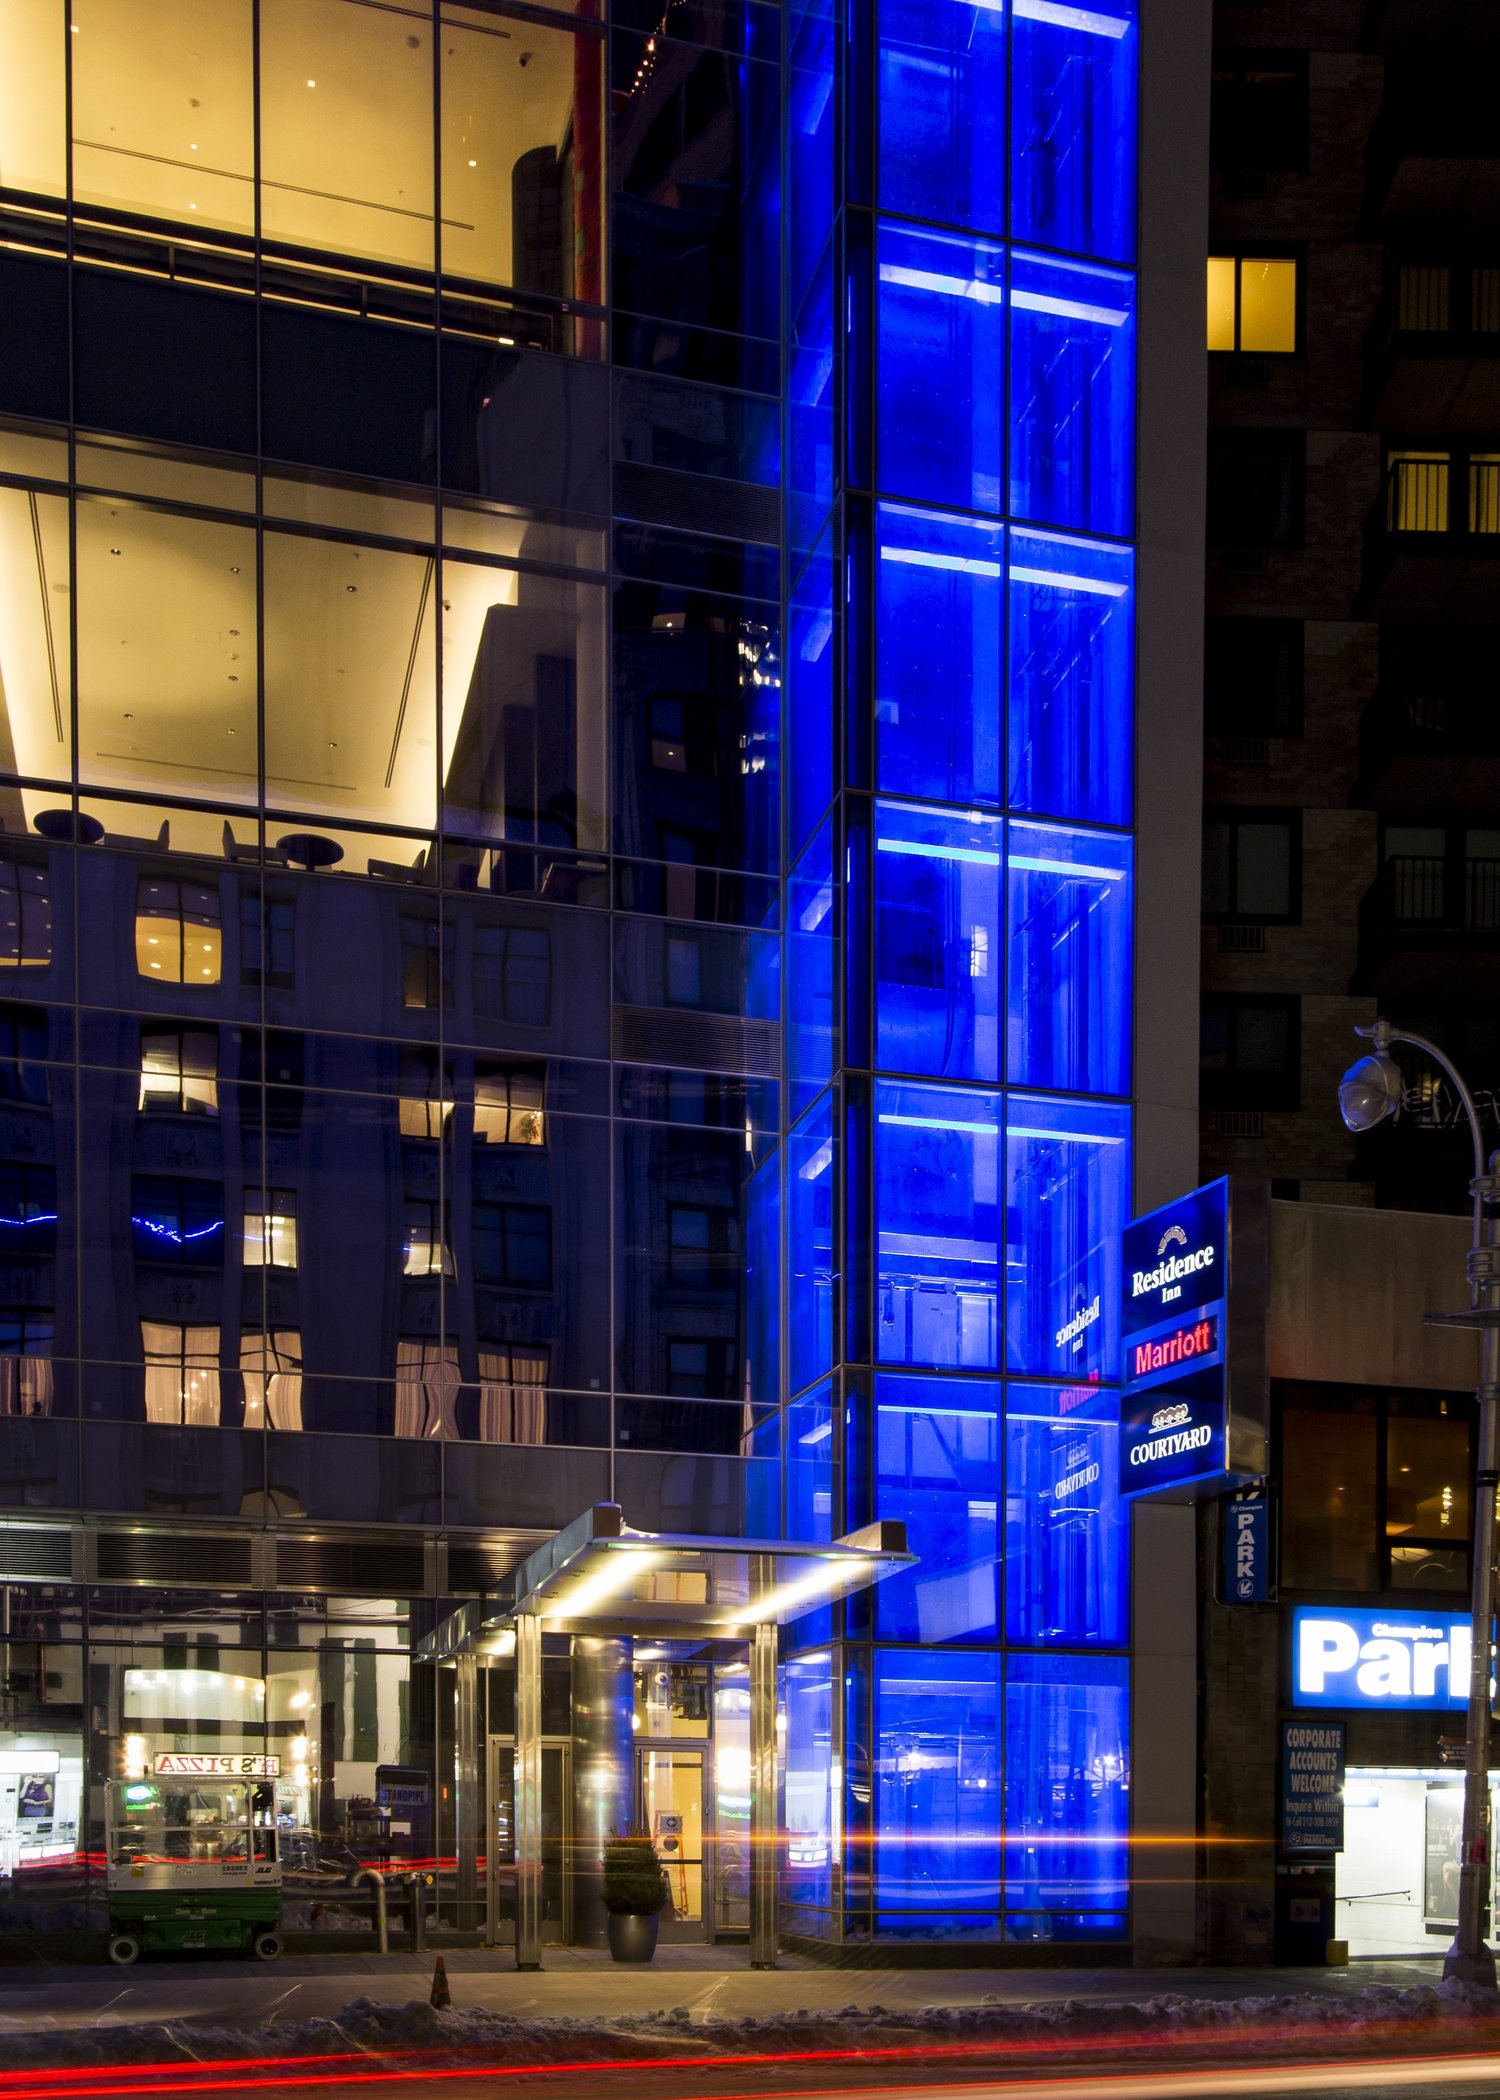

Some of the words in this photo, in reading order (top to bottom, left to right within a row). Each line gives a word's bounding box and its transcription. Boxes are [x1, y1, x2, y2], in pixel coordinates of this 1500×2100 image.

[1132, 1245, 1214, 1297] Residence
[1161, 1285, 1182, 1303] Inn
[1135, 1321, 1210, 1375] Marriott
[1130, 1424, 1212, 1466] COURTYARD
[1237, 1513, 1255, 1577] PARK
[1371, 1623, 1443, 1641] Champion
[1286, 1728, 1341, 1748] CORPORATE
[1289, 1751, 1337, 1771] ACCOUNTS
[1291, 1774, 1335, 1792] WELCOME
[382, 1788, 425, 1803] STANDPIPE
[1286, 1798, 1312, 1815] Inquire
[1314, 1798, 1339, 1812] Within
[255, 1866, 272, 1874] JLG
[184, 1931, 206, 1940] JLG
